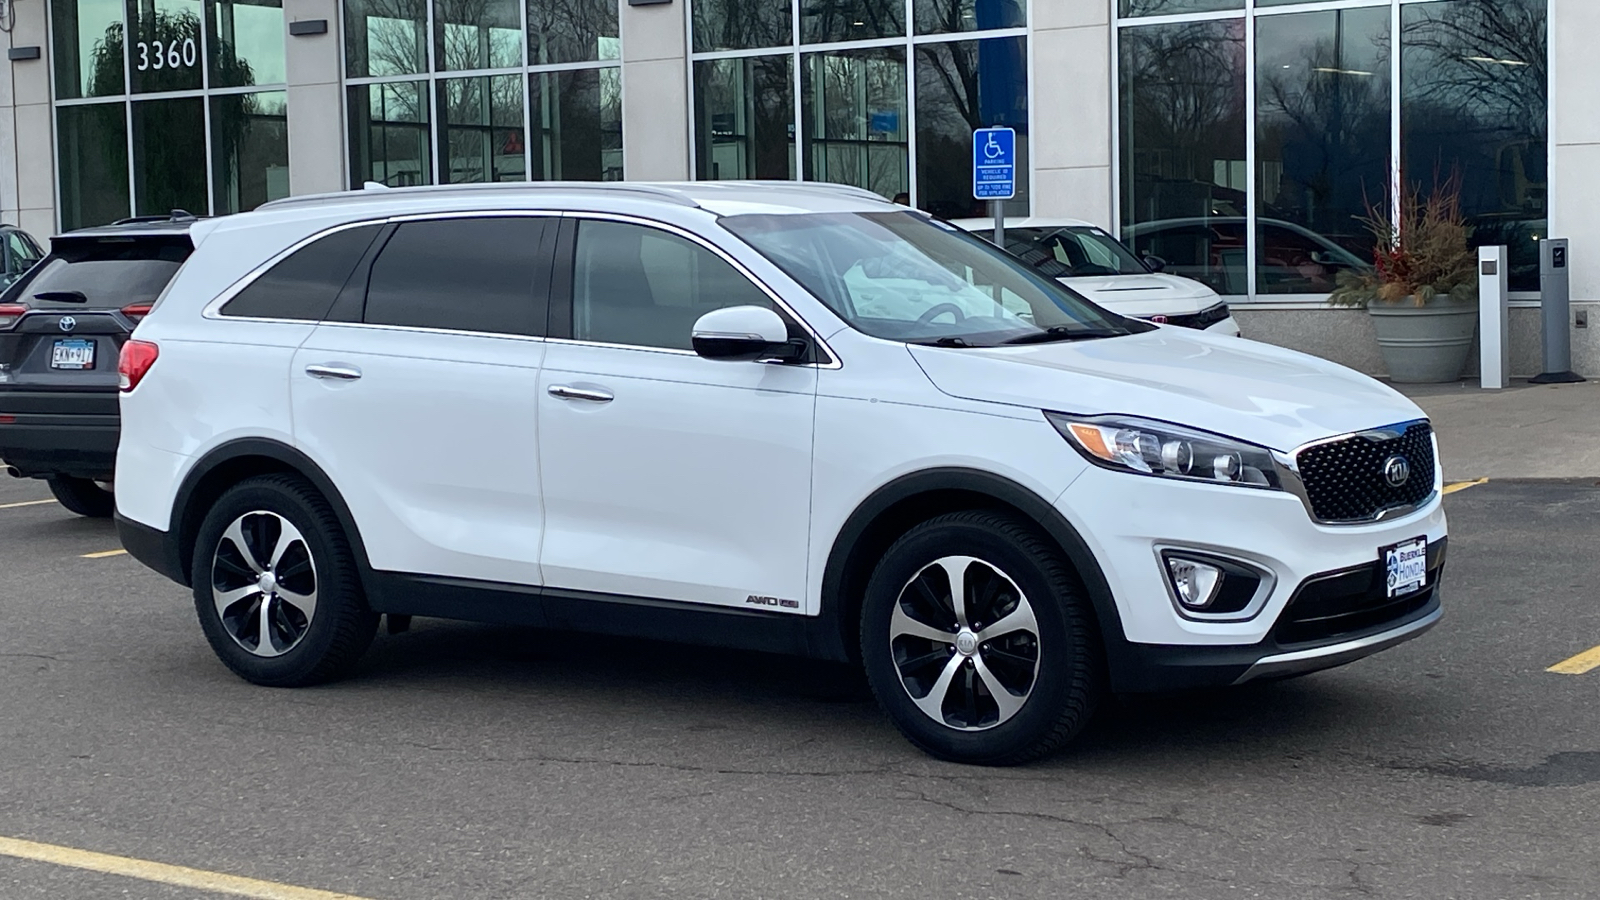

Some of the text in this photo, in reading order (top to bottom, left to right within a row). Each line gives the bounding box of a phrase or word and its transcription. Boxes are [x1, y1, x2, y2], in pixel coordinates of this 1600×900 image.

[137, 38, 196, 71] 3360
[1390, 462, 1408, 481] KIA
[1400, 547, 1426, 562] BUERKLE
[1400, 561, 1426, 581] HONDA
[746, 595, 778, 606] AWD
[959, 639, 973, 648] KIA
